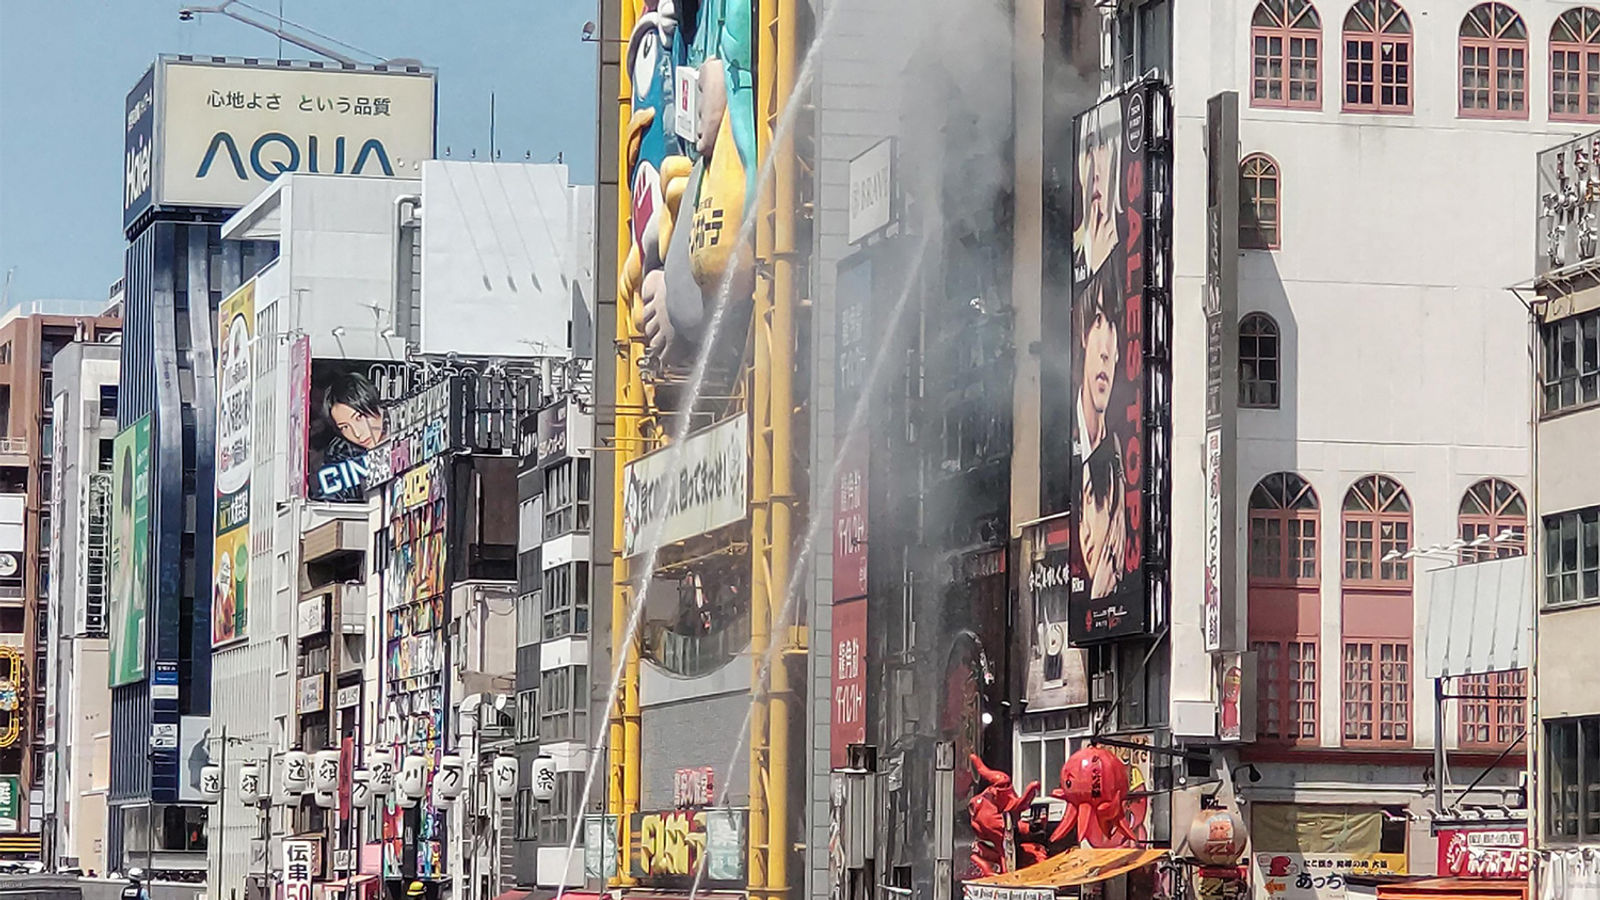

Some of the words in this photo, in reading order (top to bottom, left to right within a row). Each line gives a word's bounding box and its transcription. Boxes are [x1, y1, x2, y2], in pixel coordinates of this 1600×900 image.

[207, 90, 281, 110] 心地よさ
[298, 95, 391, 117] という品質
[196, 131, 394, 182] AQUA
[289, 759, 306, 781] 道
[405, 764, 424, 790] 川
[287, 844, 309, 881] 伝串
[1295, 871, 1345, 890] あっち
